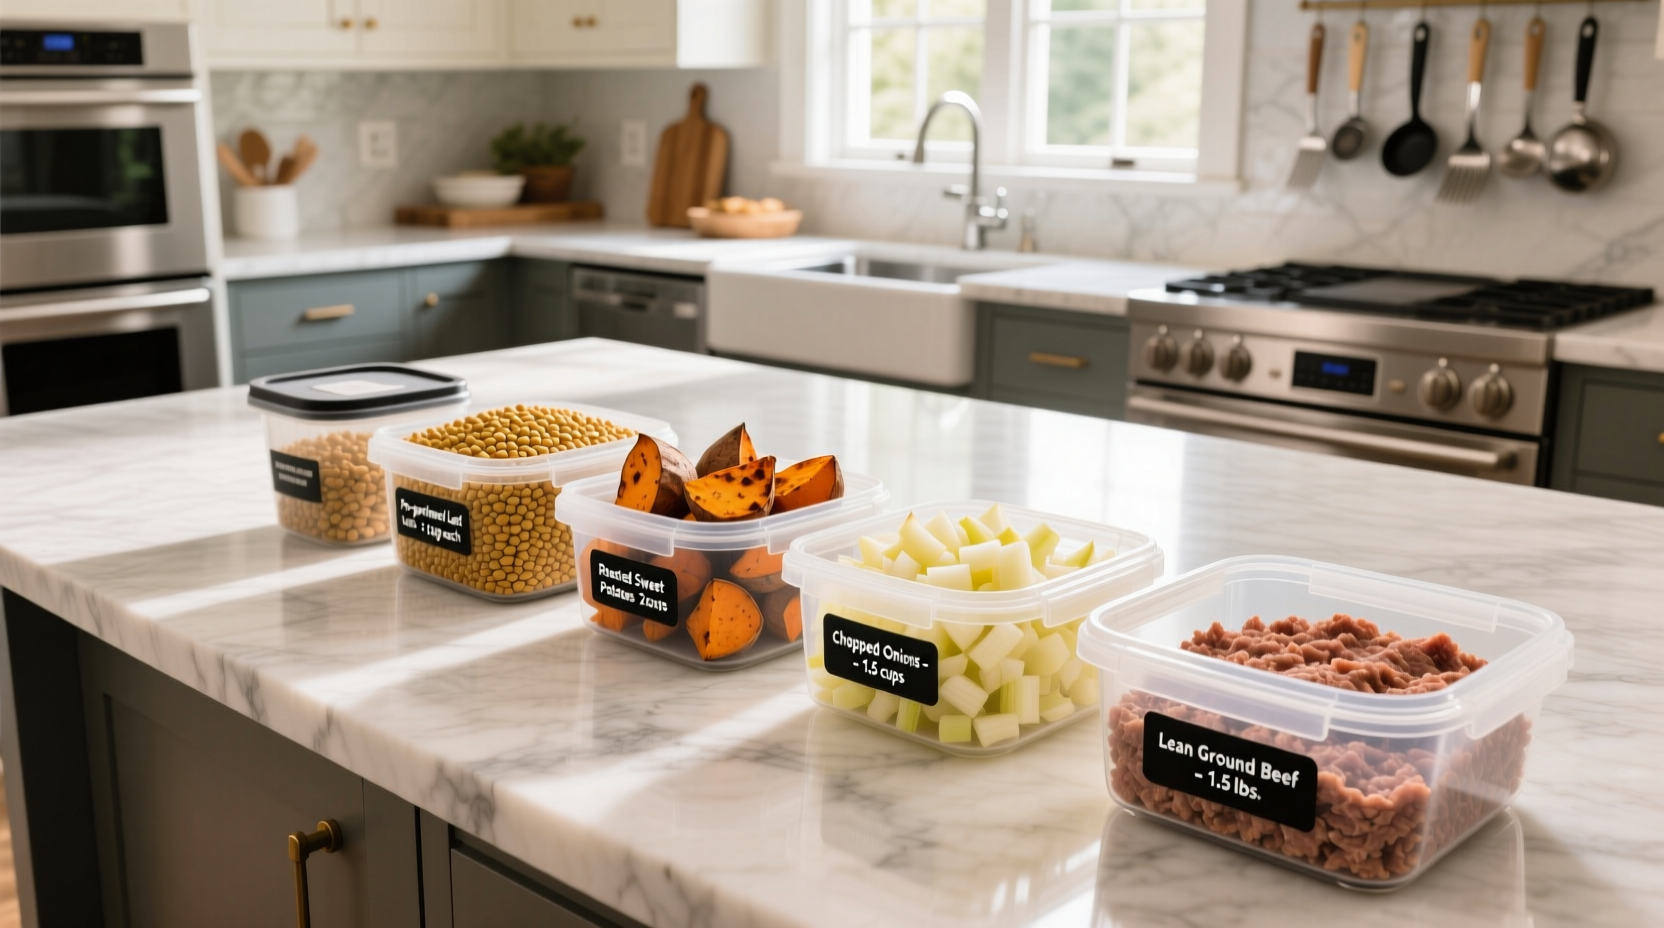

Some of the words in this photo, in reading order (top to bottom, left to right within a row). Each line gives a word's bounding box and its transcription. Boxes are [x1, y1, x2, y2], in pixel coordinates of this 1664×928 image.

[832, 630, 880, 656] Chopped
[862, 659, 878, 676] 1.5
[880, 668, 906, 687] cups
[1158, 731, 1194, 758] Lean
[1197, 744, 1256, 776] Ground
[1260, 761, 1300, 789] Beef
[1207, 770, 1231, 791] 1.5
